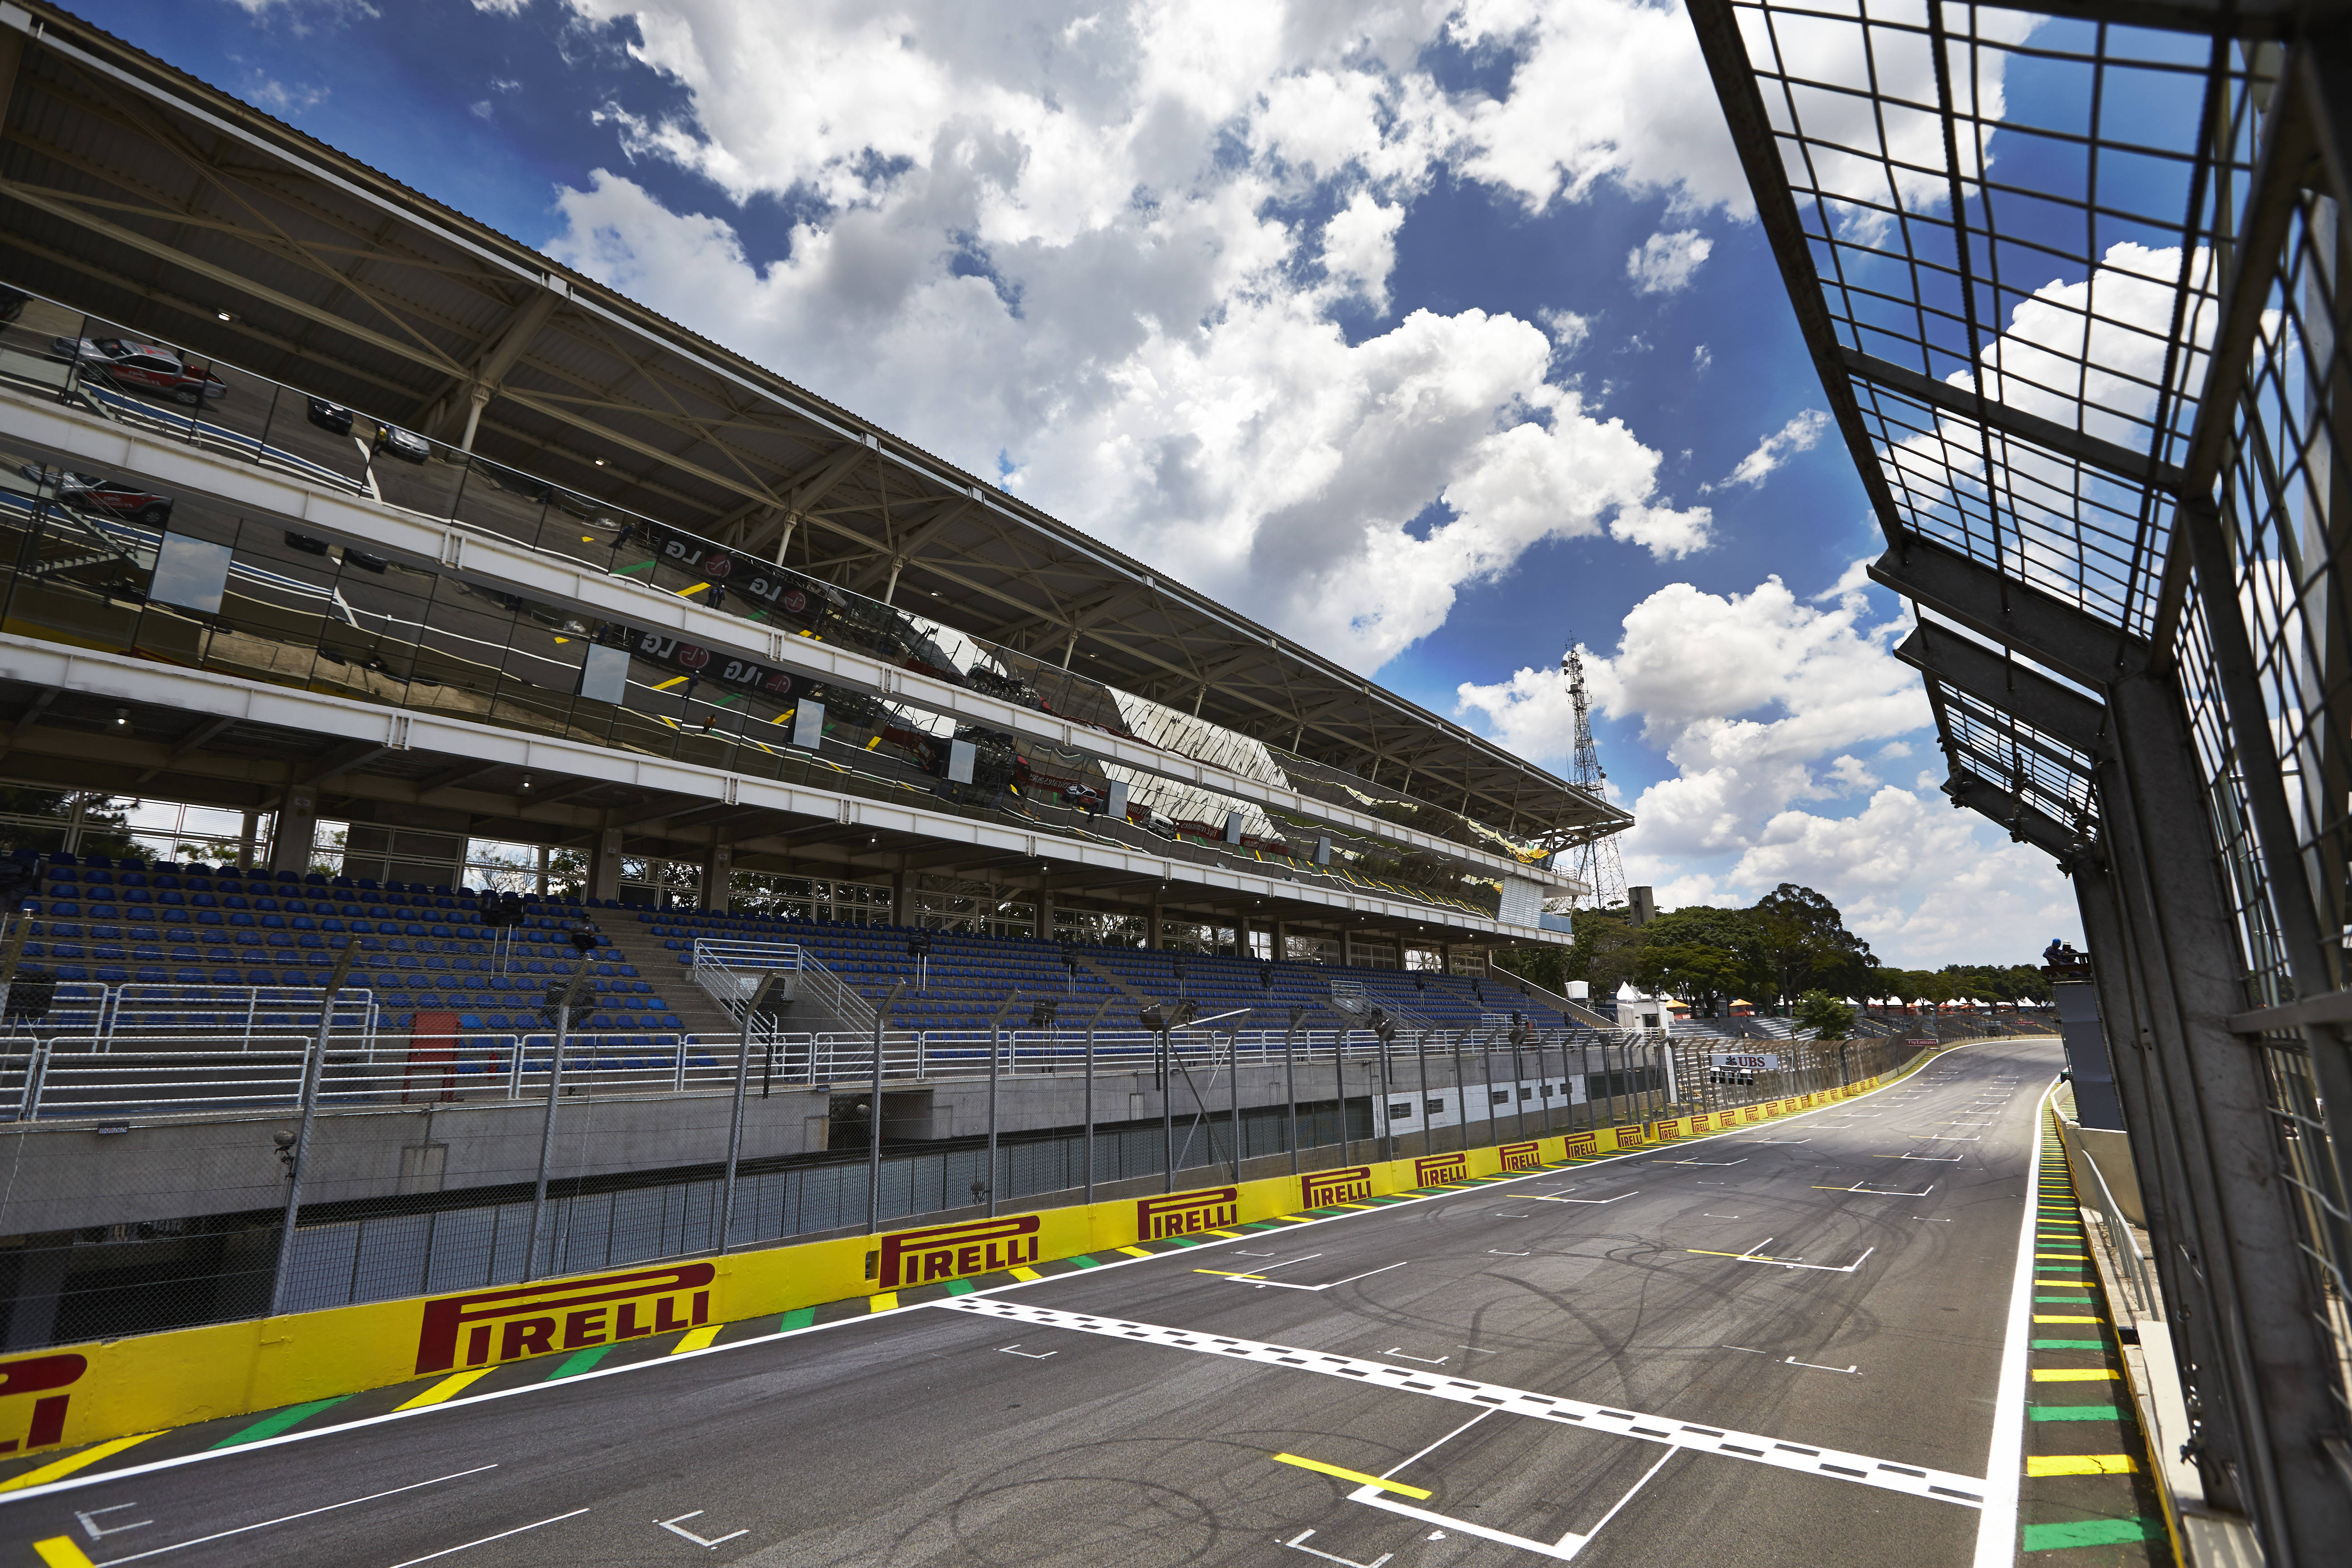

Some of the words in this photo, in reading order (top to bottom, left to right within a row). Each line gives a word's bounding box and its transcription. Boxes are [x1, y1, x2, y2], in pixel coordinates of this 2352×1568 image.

[1738, 1057, 1765, 1067] UBS
[1720, 1111, 1736, 1127] PIRELLI
[1745, 1107, 1759, 1121] PIRELLI
[1766, 1102, 1779, 1117] PIRELLI
[1657, 1120, 1679, 1140] PIRELLI
[1691, 1115, 1710, 1133] PIRELLI
[1564, 1132, 1597, 1158] PIRELLI
[1616, 1126, 1642, 1147] PIRELLI
[1499, 1142, 1540, 1171] PIRELLI
[1415, 1153, 1467, 1188] PIRELLI
[1301, 1167, 1372, 1209] PIRELLI
[1137, 1187, 1237, 1240] PIRELLI
[879, 1215, 1039, 1288] PIRELLI
[415, 1263, 715, 1375] PIRELLI
